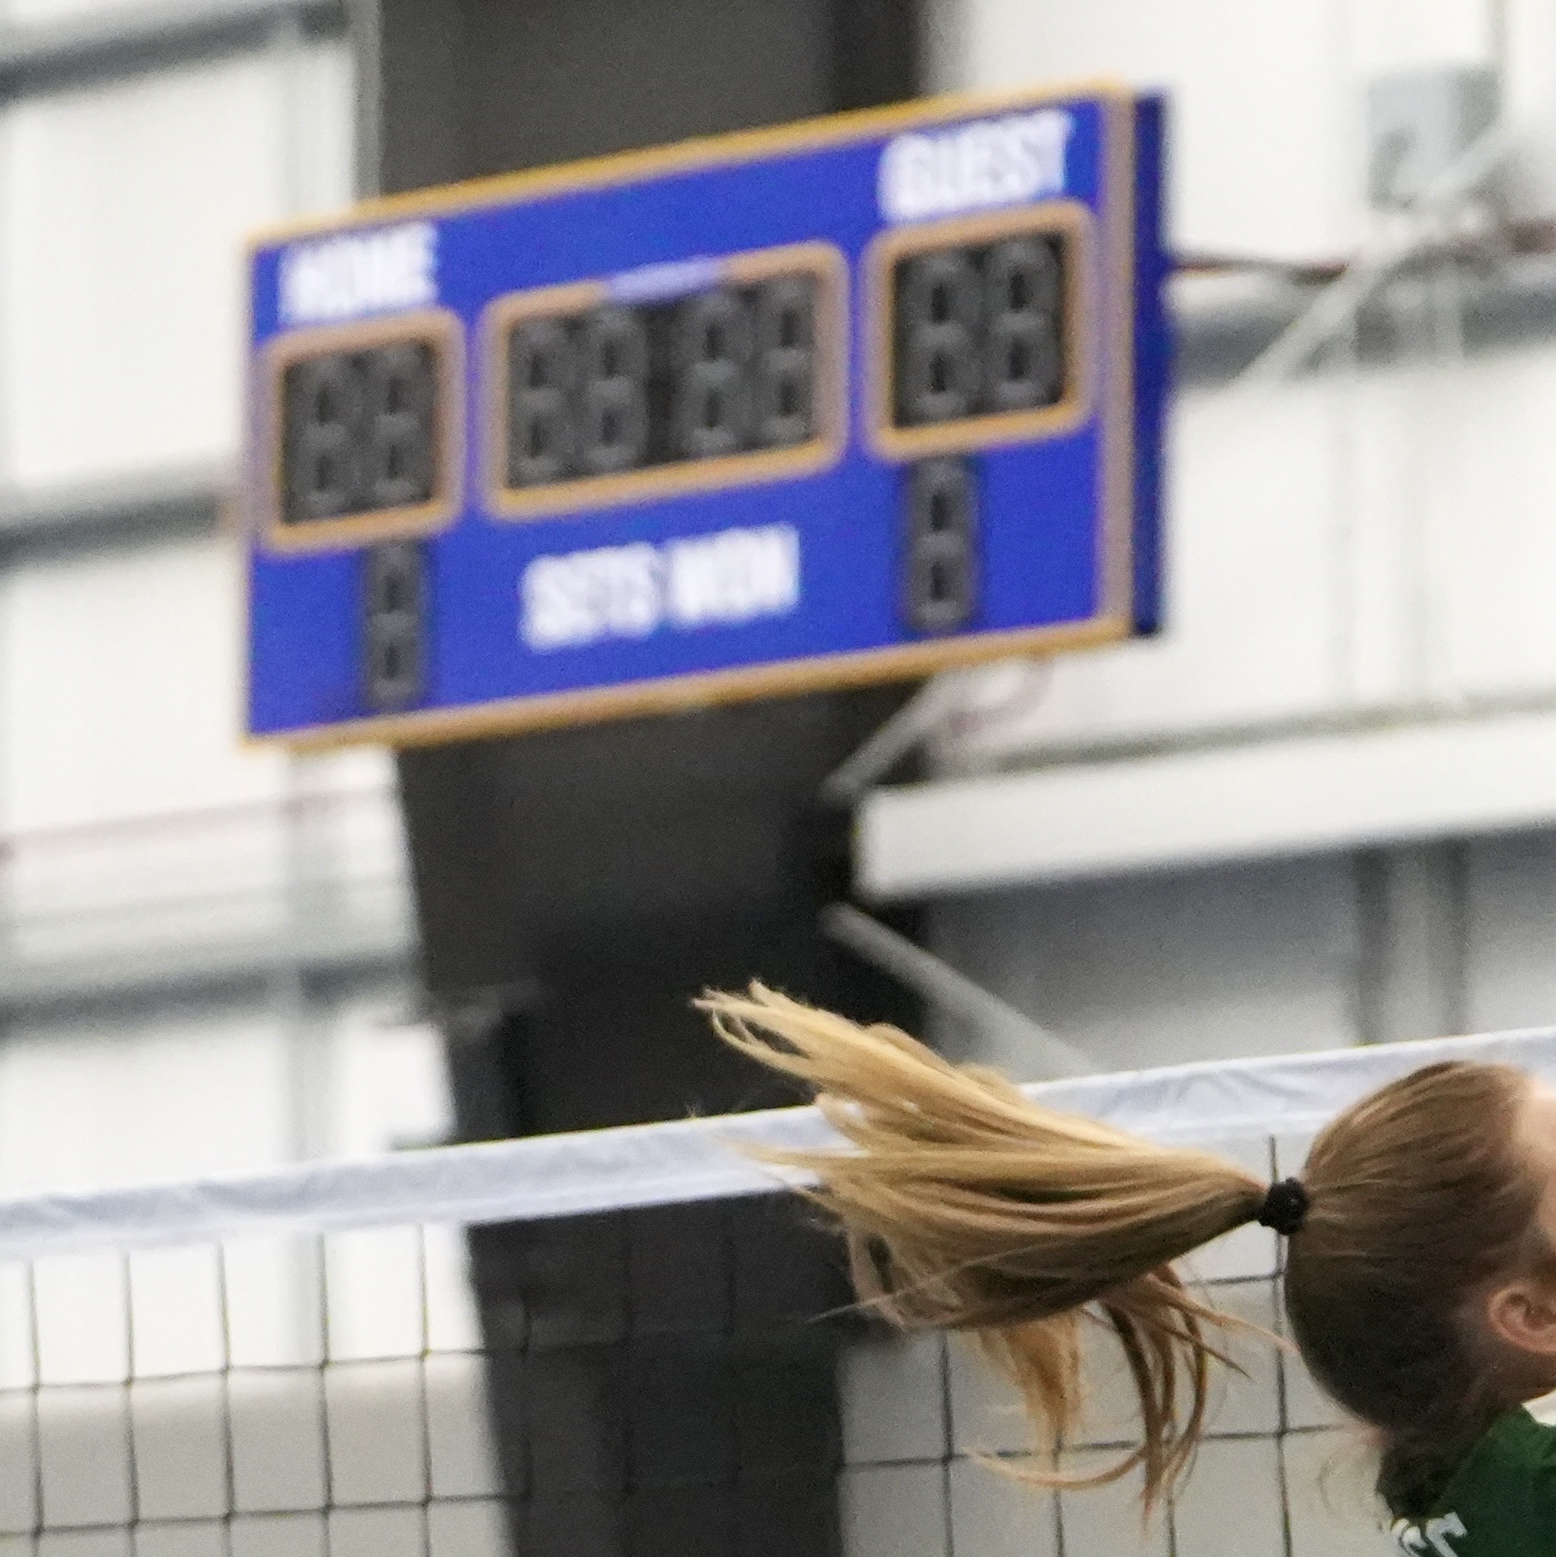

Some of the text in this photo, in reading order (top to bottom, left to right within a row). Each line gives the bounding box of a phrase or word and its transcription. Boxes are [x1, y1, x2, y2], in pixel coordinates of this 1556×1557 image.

[879, 110, 1071, 219] GUEST
[280, 223, 437, 321] HOME
[521, 522, 800, 653] SETS WON
